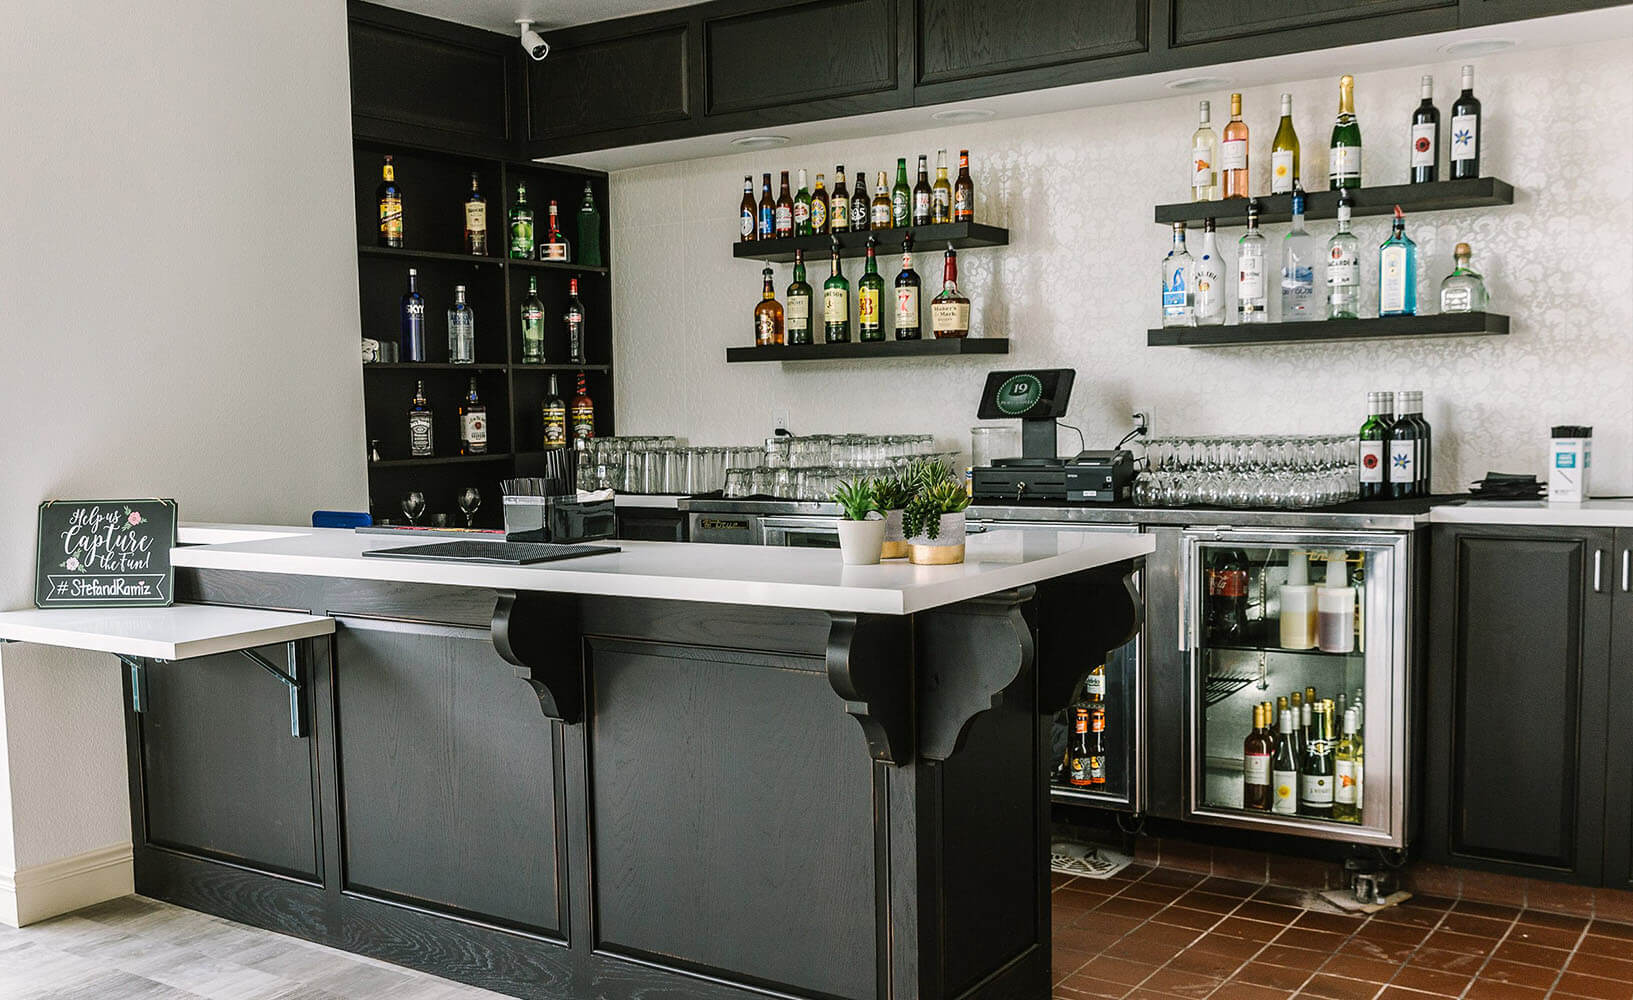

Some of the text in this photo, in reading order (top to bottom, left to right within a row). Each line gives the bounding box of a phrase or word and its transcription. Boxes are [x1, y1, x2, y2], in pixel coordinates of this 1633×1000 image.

[1013, 383, 1029, 394] 19
[69, 506, 121, 533] Help us
[60, 523, 154, 567] Capture
[97, 550, 120, 571] the
